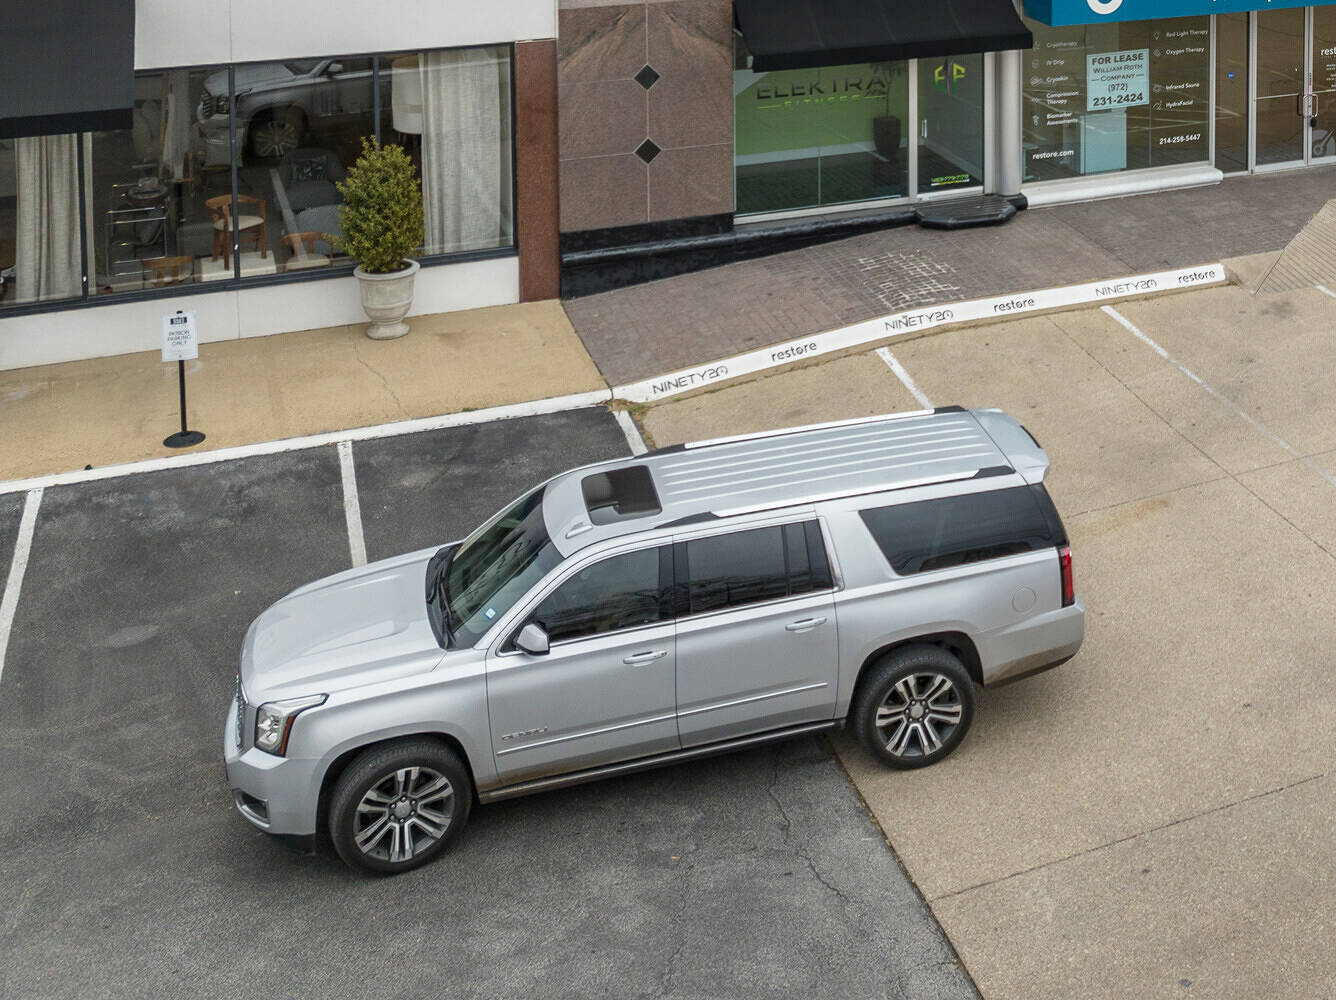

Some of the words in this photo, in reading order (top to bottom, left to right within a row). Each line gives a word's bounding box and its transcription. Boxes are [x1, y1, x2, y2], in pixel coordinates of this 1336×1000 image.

[1166, 48, 1184, 56] Oxygen
[1185, 46, 1204, 54] Therapy
[1092, 55, 1111, 66] FOR
[1114, 53, 1144, 63] LEASE
[1093, 66, 1122, 74] WILLIAM
[1101, 73, 1135, 81] COMPANY
[757, 77, 886, 99] ELEKTRA
[1108, 83, 1128, 93] (972)
[1093, 93, 1143, 107] 231-2424
[1032, 149, 1074, 160] restore.com
[1178, 270, 1216, 284] restore
[993, 298, 1035, 313] restore
[771, 341, 817, 362] restore
